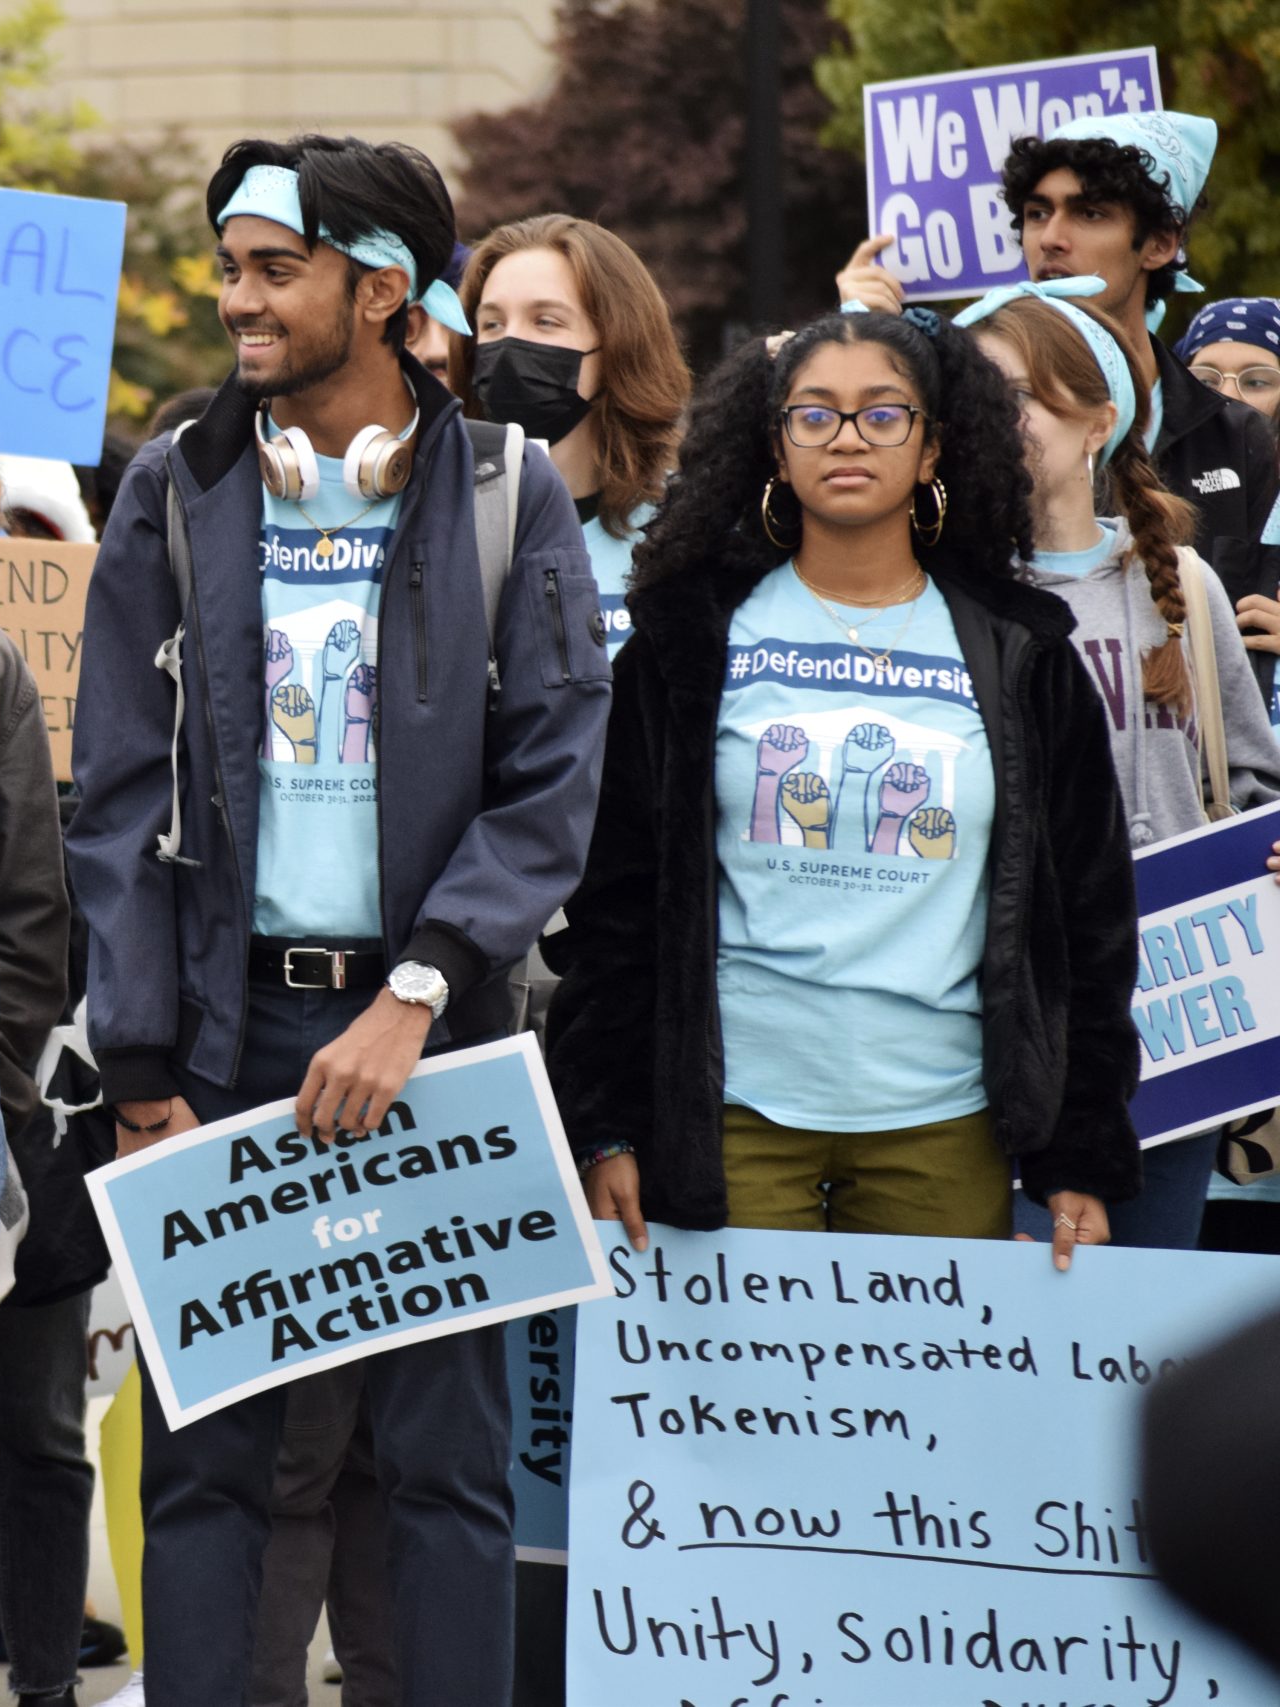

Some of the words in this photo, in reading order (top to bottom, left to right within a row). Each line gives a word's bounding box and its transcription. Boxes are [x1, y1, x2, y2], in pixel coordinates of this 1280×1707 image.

[877, 94, 968, 185] We
[880, 192, 964, 284] Go
[730, 648, 978, 709] #DefendDiversit
[280, 792, 325, 803] OCTOBER
[291, 779, 345, 791] SUPREME
[766, 858, 795, 872] U.S.
[800, 861, 873, 880] SUPREME
[877, 868, 931, 884] COURT
[788, 875, 840, 889] OCTOBER
[843, 881, 873, 893] 30-31,
[878, 883, 905, 894] 2022
[163, 1125, 518, 1261] Americans
[312, 1208, 383, 1249] for
[179, 1210, 558, 1350] Affirmative
[608, 1245, 813, 1303] Stolen
[830, 1258, 994, 1324] Land,
[271, 1273, 490, 1362] Action
[615, 1319, 1037, 1380] Uncompensated
[1071, 1340, 1188, 1387] Labo
[520, 1308, 573, 1488] ersity
[610, 1392, 939, 1452] Tokenism,
[620, 1479, 667, 1551] &
[699, 1499, 842, 1540] now
[873, 1491, 992, 1551] this
[593, 1585, 814, 1687] Unity,
[836, 1608, 1220, 1702] Solidarity,
